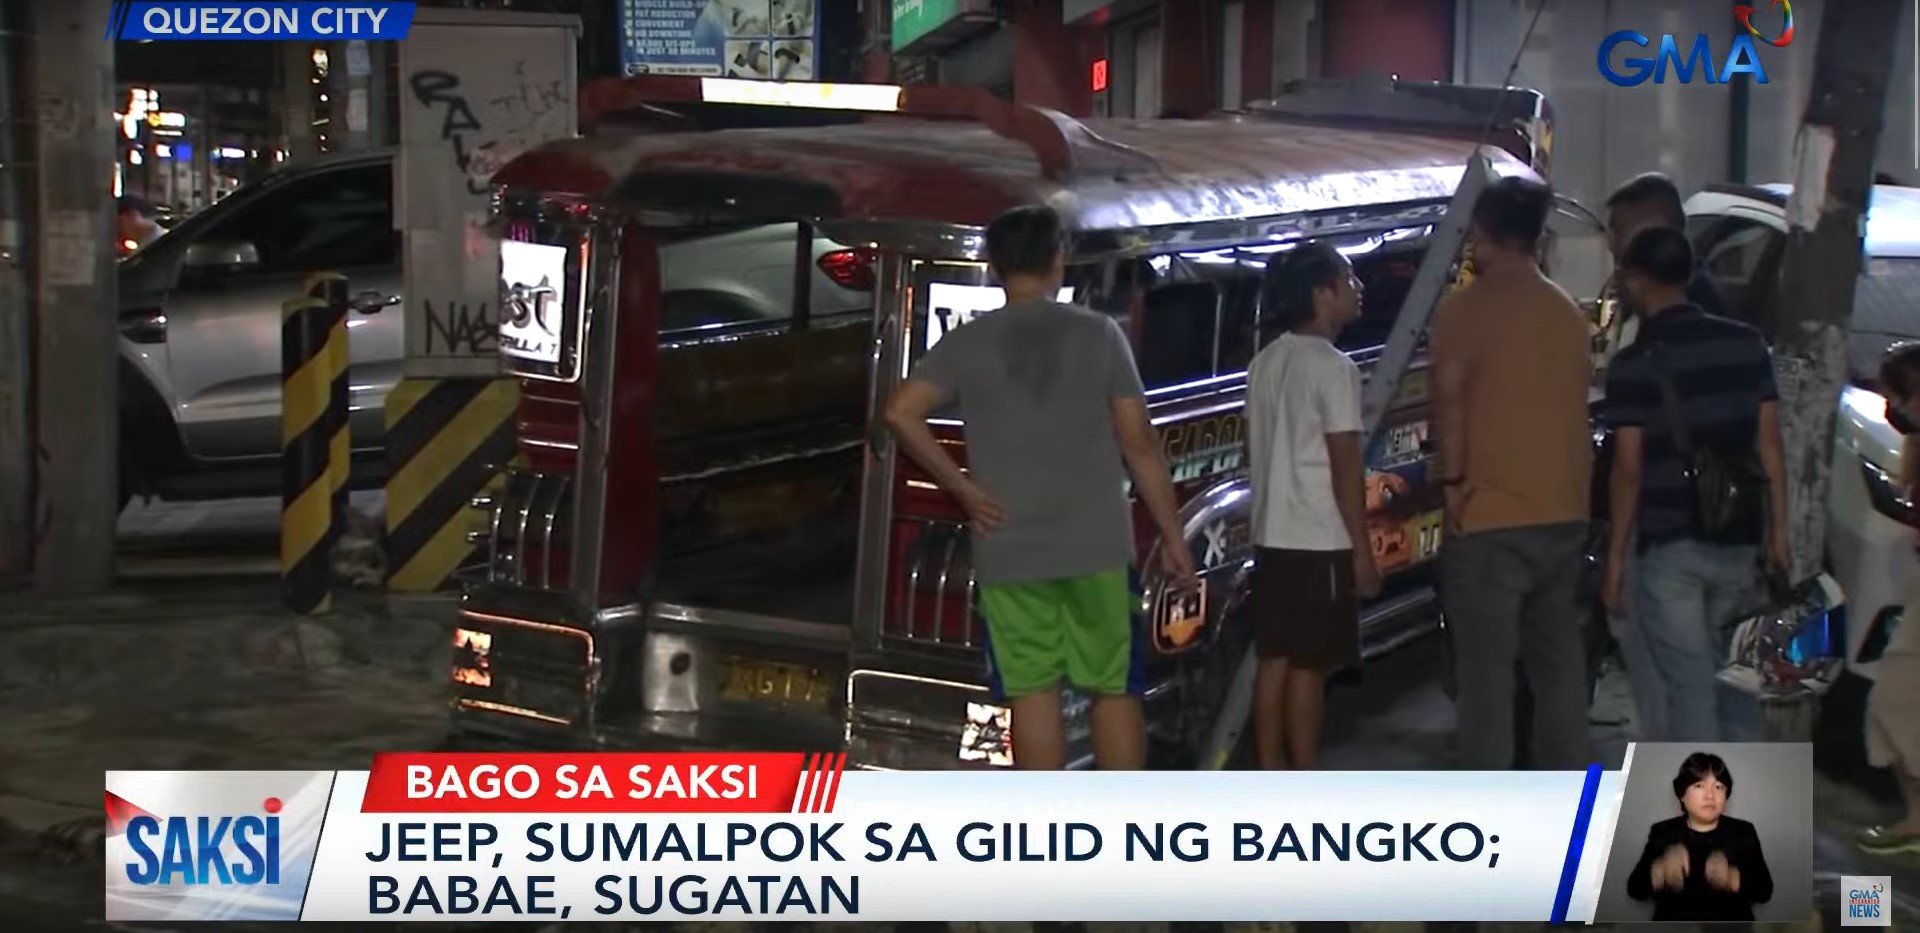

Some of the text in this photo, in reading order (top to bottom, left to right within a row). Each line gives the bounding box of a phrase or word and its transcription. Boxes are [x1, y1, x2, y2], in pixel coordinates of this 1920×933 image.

[635, 10, 696, 18] FAT REDUCTION
[635, 20, 685, 28] CONVENIENT
[649, 30, 692, 38] DOWNTIME
[646, 47, 665, 55] JUST
[680, 47, 716, 55] MINUTES
